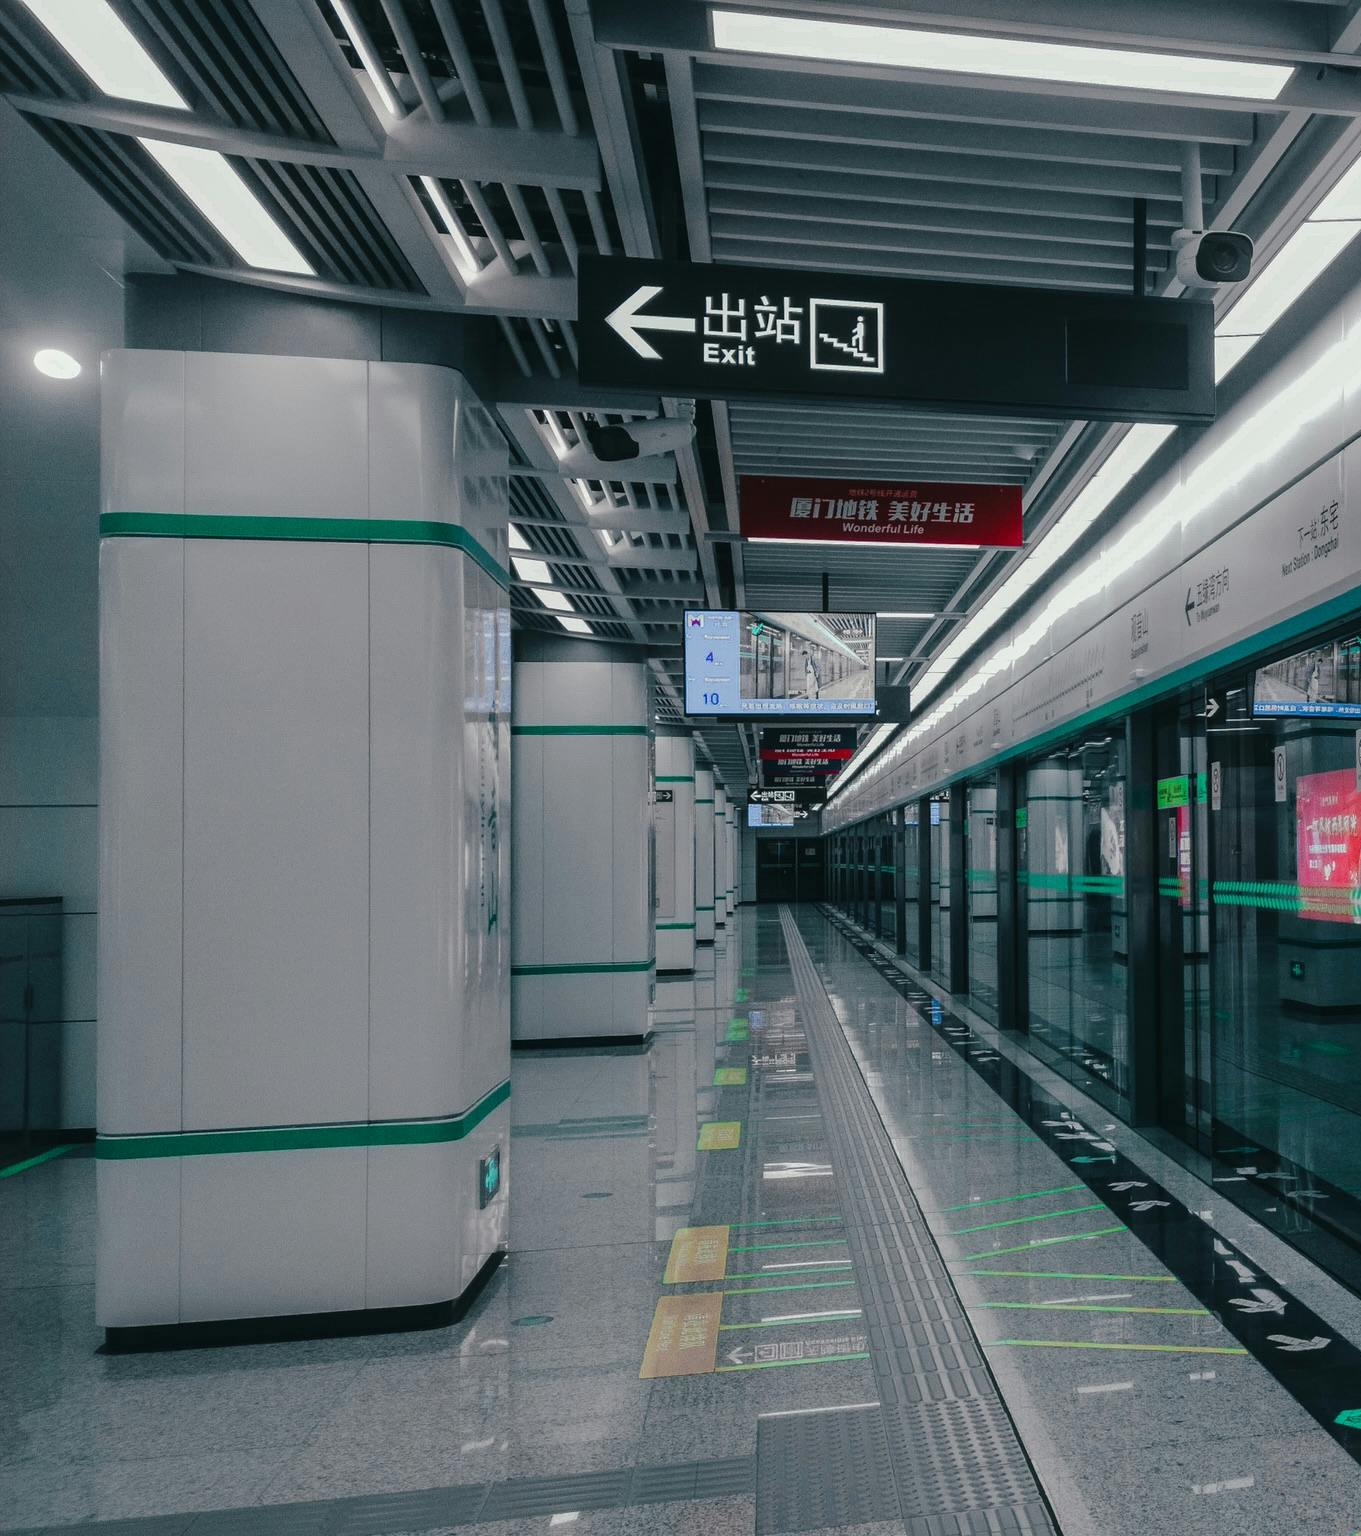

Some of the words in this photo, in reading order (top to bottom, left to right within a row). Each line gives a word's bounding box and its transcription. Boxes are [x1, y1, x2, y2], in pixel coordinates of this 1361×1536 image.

[702, 292, 803, 345] 出站
[704, 342, 756, 366] Exit
[789, 497, 879, 521] 厦门地铁
[887, 500, 976, 524] 美好生活
[842, 522, 901, 534] Wonderful
[903, 523, 925, 535] Life
[1281, 560, 1293, 577] Next
[1293, 551, 1310, 572] Station
[705, 651, 714, 663] 4
[703, 693, 720, 705] 10
